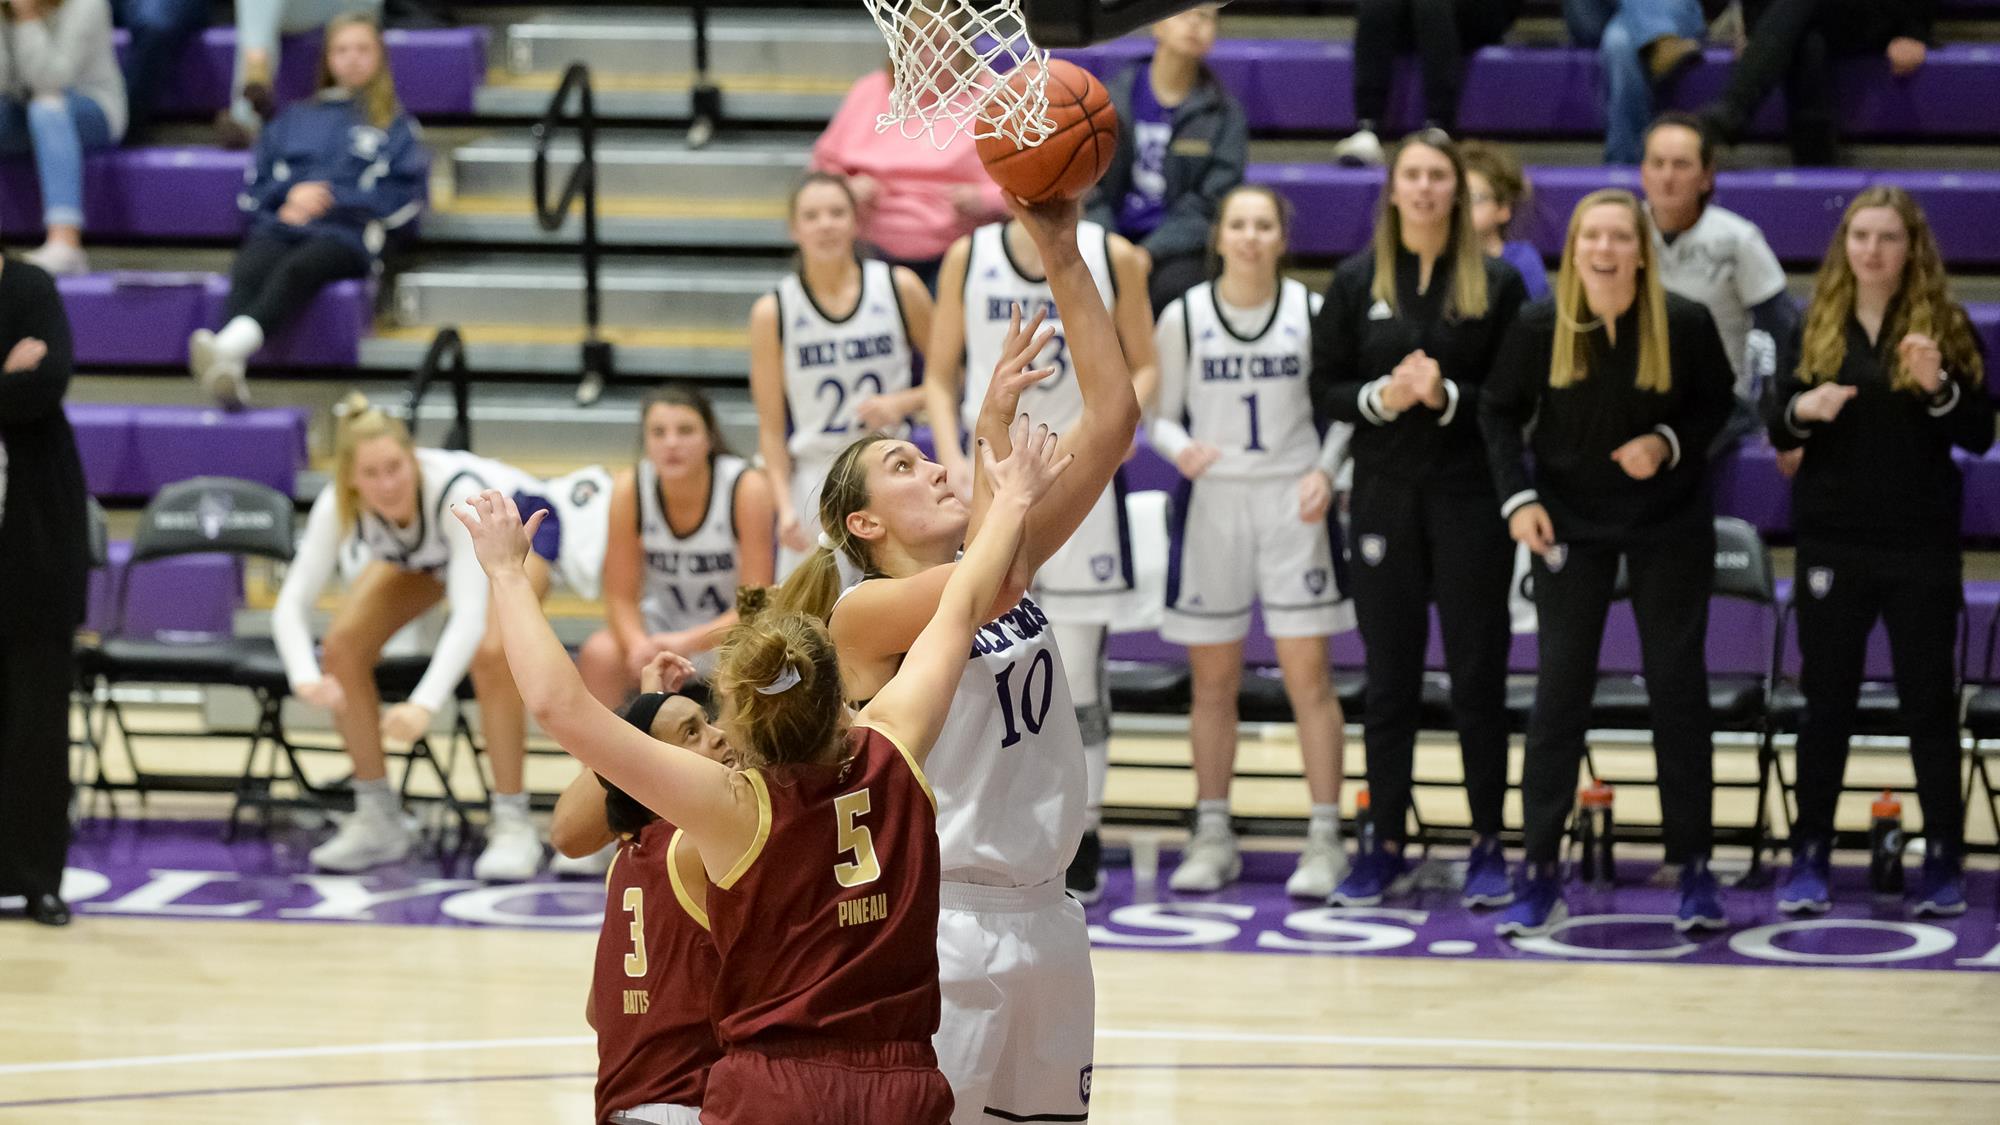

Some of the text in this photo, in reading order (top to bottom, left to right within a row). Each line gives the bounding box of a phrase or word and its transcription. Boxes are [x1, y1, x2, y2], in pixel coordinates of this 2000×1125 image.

[1249, 355, 1299, 378] CROSS
[1240, 393, 1268, 451] 1
[995, 648, 1053, 748] 10
[834, 788, 881, 888] 5
[623, 887, 647, 977] 3
[838, 893, 888, 928] PINEAU
[623, 989, 650, 1014] BATTS
